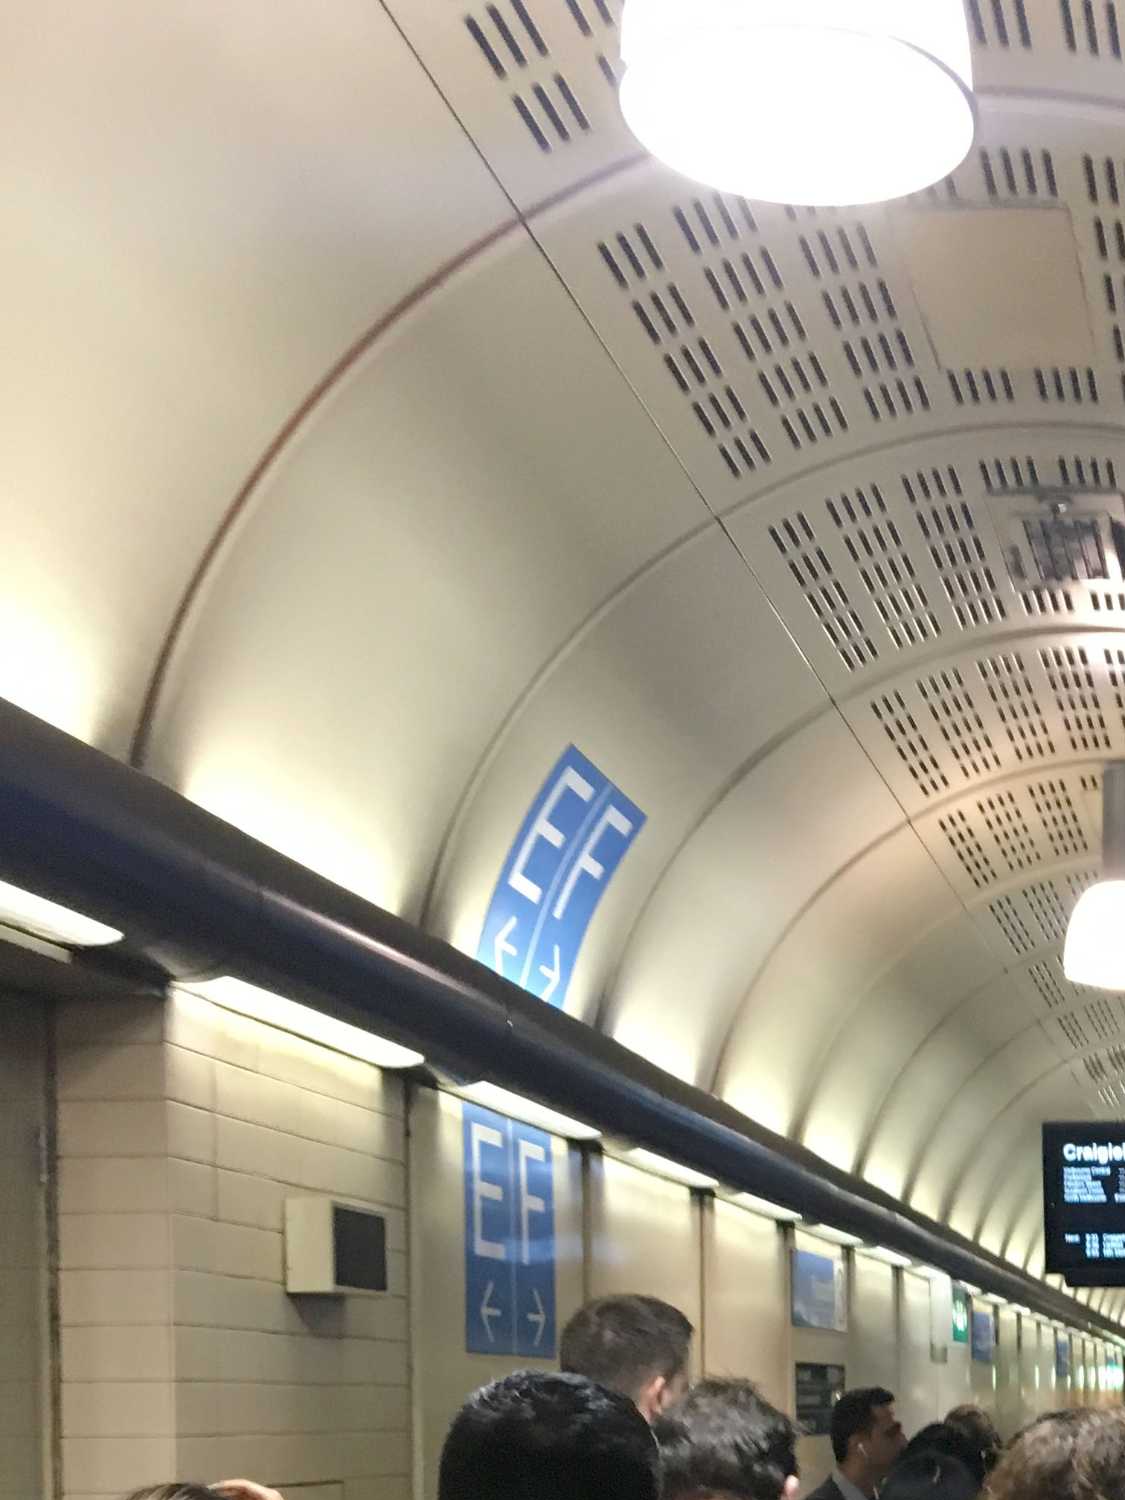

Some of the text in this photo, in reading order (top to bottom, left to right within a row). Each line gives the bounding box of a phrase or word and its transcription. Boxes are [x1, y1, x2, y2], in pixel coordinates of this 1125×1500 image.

[508, 764, 634, 920] E F
[471, 1121, 546, 1265] E F
